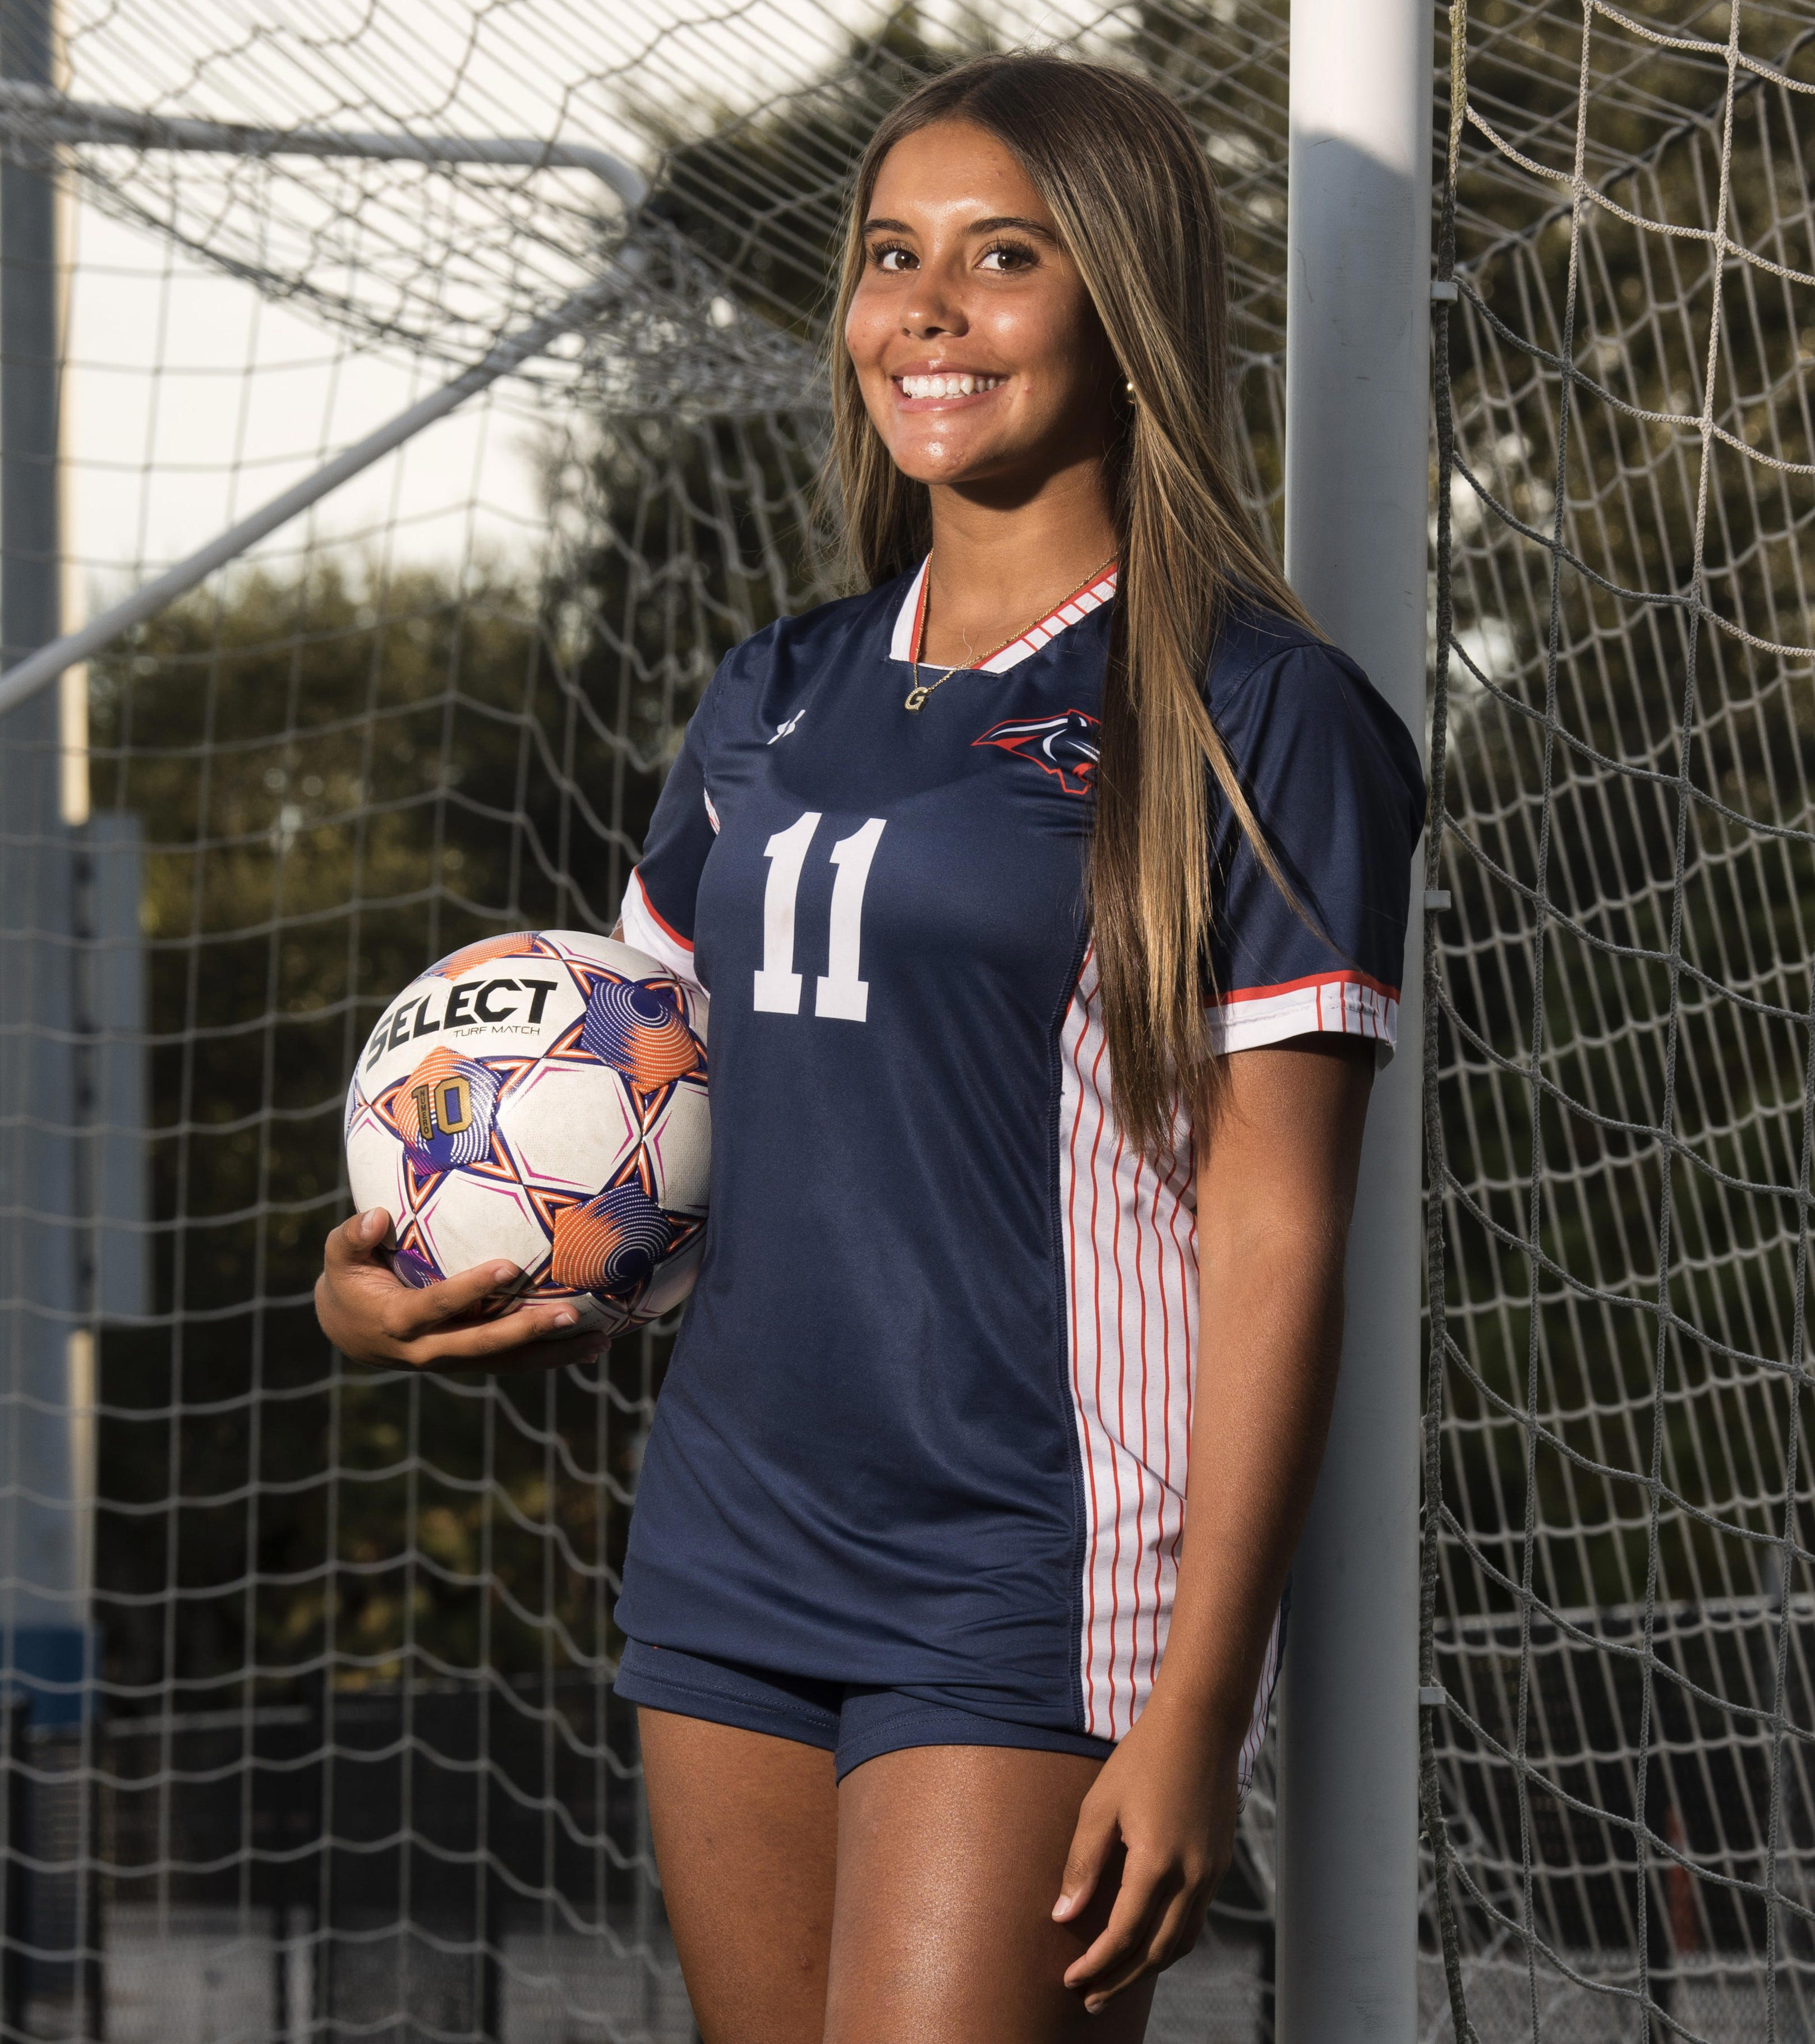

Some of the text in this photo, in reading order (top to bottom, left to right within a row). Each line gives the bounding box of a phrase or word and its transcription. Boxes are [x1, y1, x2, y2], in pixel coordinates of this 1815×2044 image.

[753, 811, 888, 1023] 11
[365, 978, 559, 1074] SELECT
[453, 1026, 540, 1038] TURF MATCH
[411, 1075, 473, 1142] 10
[420, 1090, 430, 1134] NUMERO
